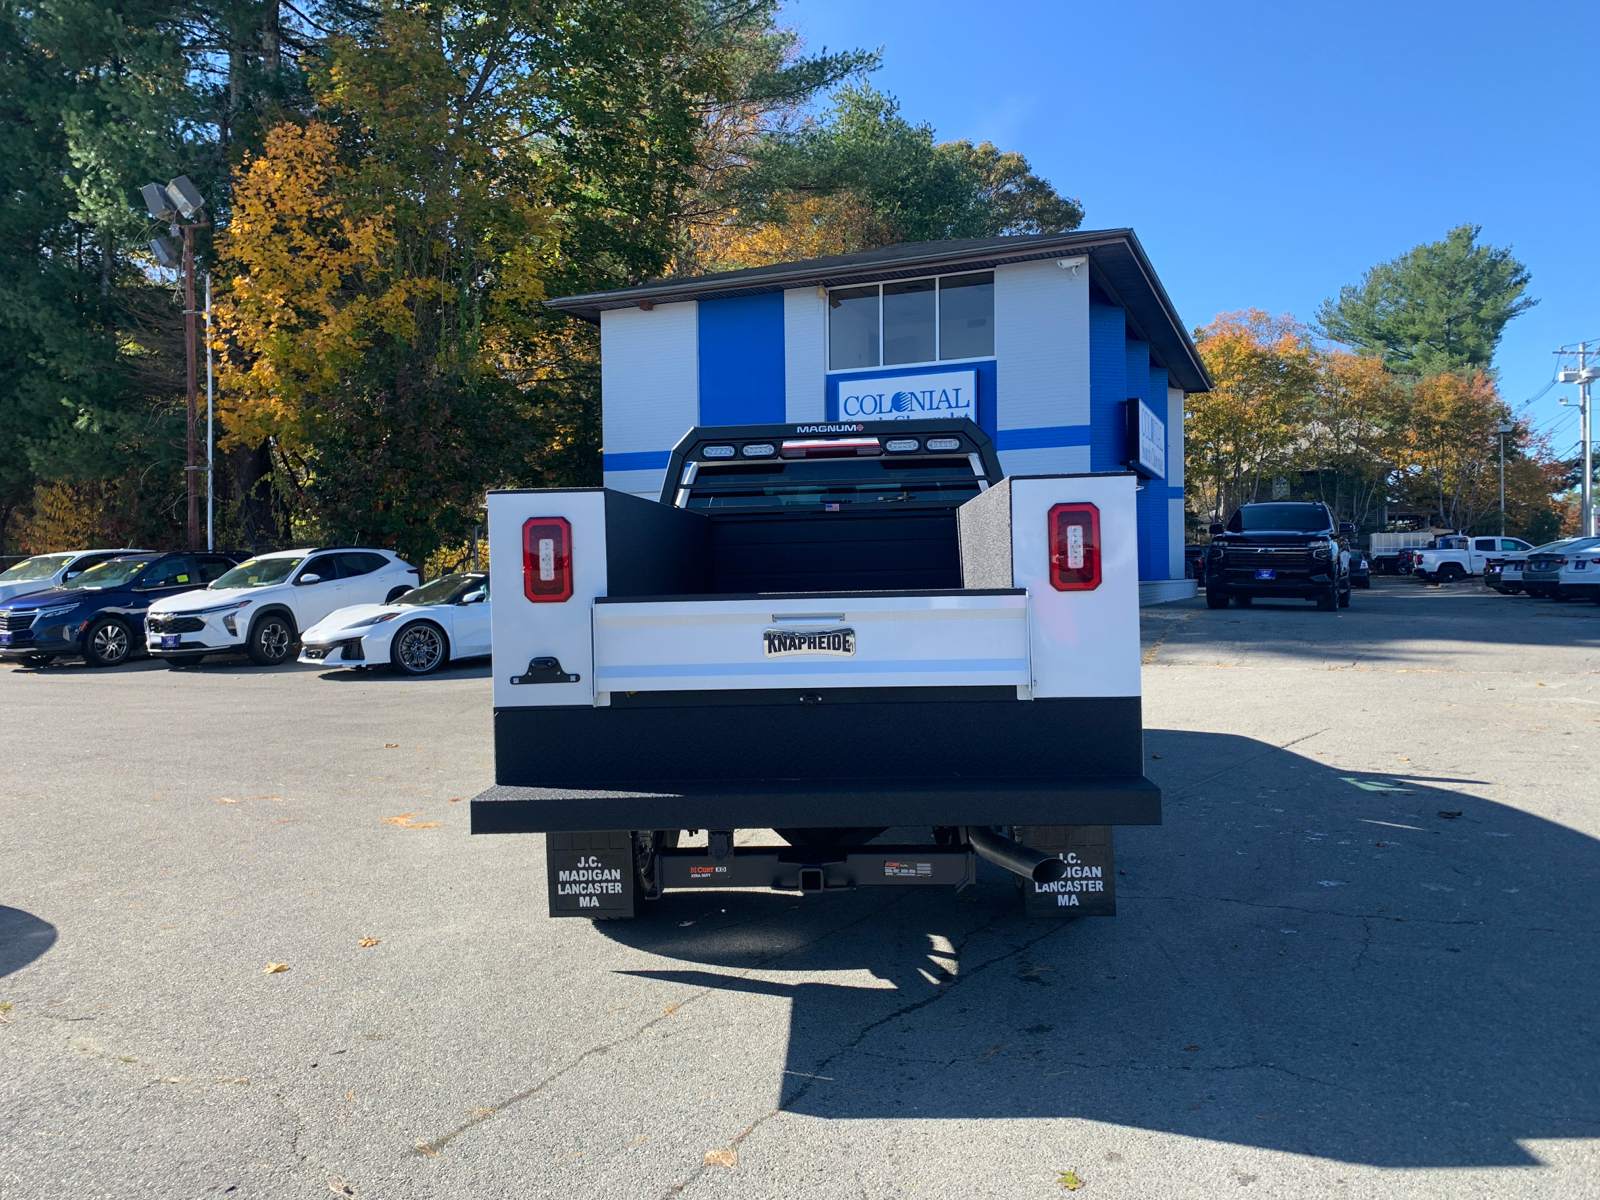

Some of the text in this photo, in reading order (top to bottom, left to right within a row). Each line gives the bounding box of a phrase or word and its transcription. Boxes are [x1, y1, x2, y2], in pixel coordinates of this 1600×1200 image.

[843, 388, 970, 416] COLONIAL
[796, 424, 857, 433] MAGNUM
[767, 631, 851, 654] KNAPHEIDE
[577, 856, 602, 868] J.C.
[558, 869, 621, 882] MADIGAN
[1060, 866, 1102, 878] IGAN
[557, 882, 623, 895] LANCASTER
[1034, 880, 1104, 893] LANCASTER
[579, 896, 600, 907] MA
[1057, 894, 1080, 906] MA
